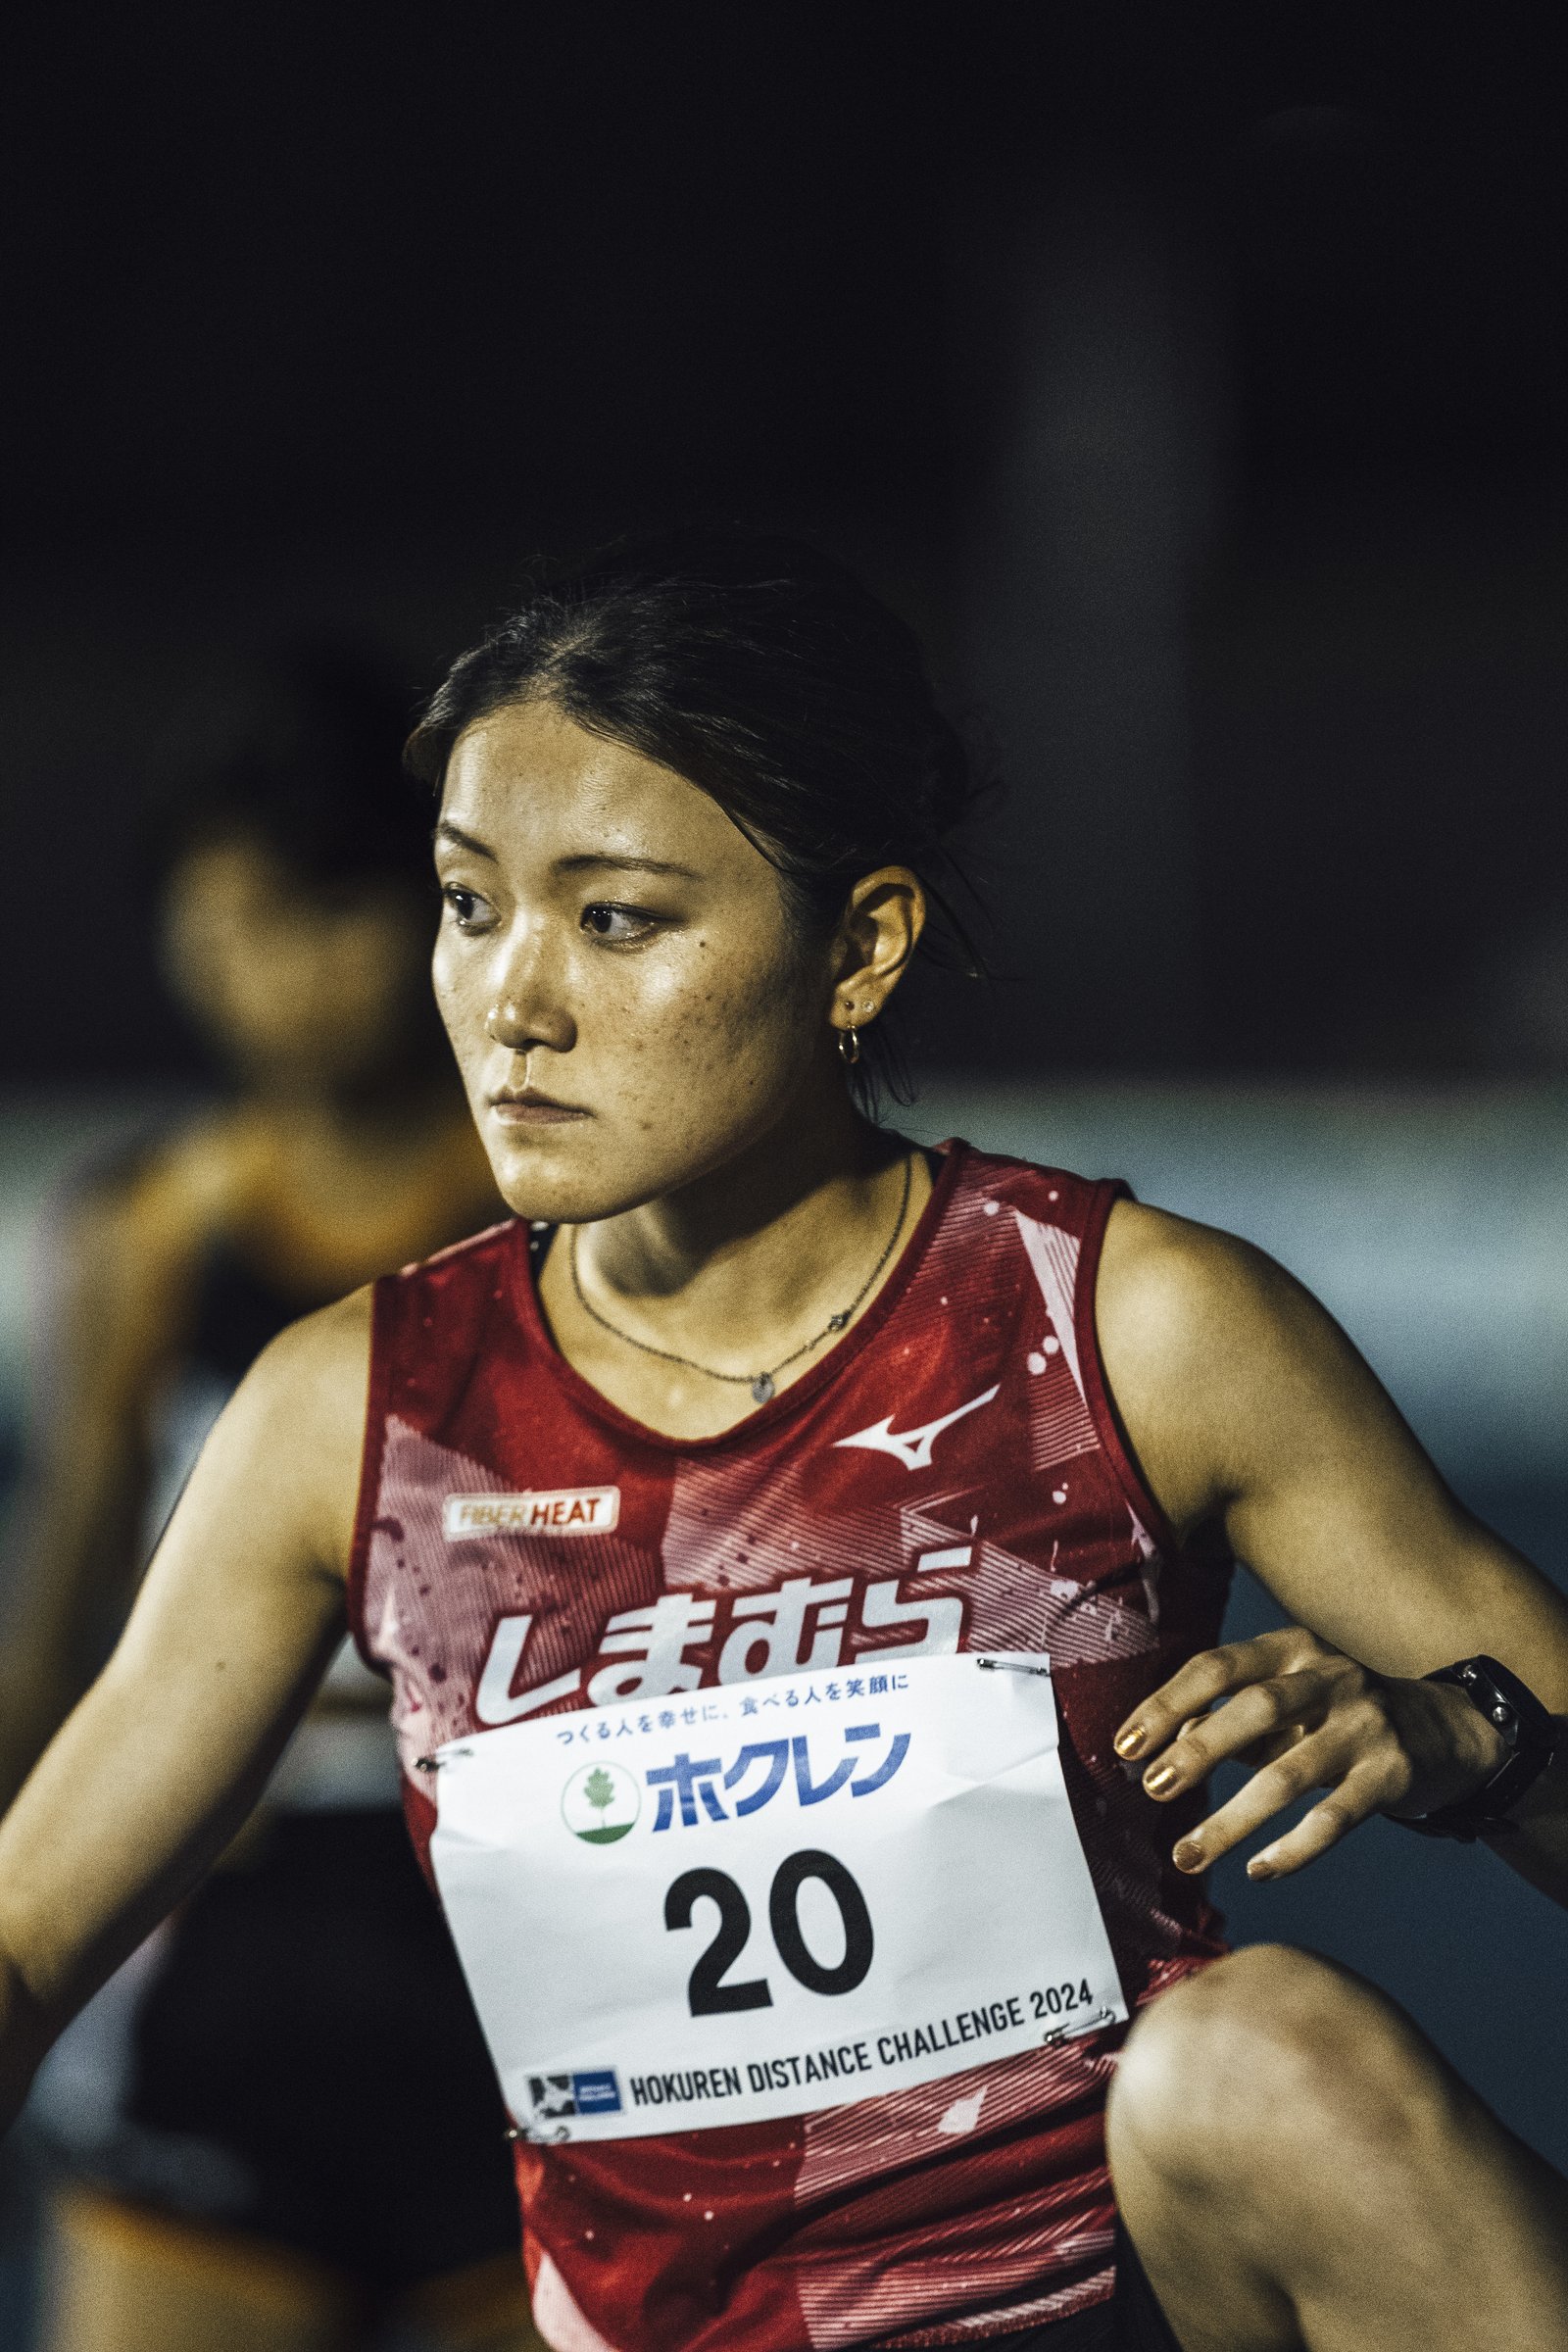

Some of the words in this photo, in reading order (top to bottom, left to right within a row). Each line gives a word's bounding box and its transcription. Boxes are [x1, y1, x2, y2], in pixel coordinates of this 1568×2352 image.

[476, 1546, 972, 1726] しまむら
[646, 1723, 911, 1833] ホクレン
[663, 1848, 874, 2018] 20
[630, 2067, 742, 2106] HOKUREN
[748, 2042, 871, 2091] DISTANCE
[877, 1997, 1025, 2065] CHALLENGE
[1029, 1978, 1094, 2021] 2024
